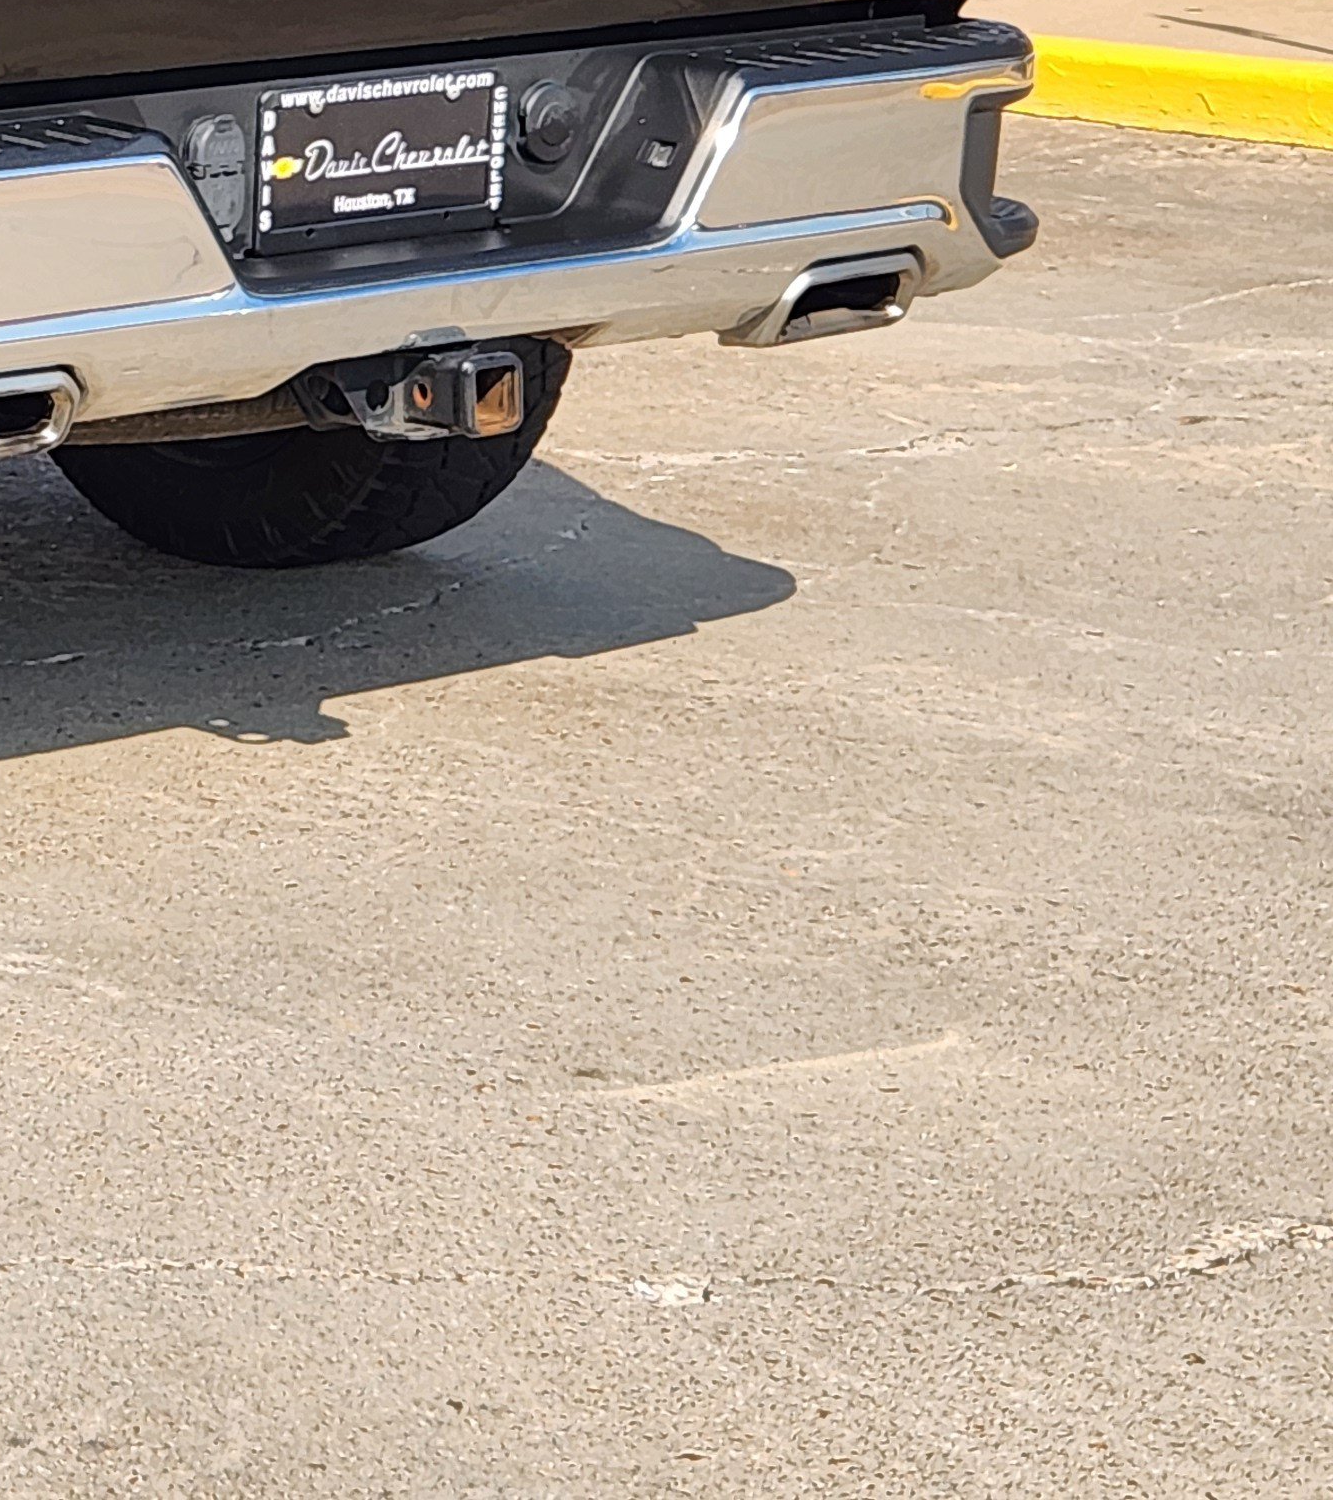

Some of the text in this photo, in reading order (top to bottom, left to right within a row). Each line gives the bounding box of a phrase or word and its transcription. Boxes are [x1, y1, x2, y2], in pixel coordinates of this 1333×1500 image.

[280, 71, 495, 109] www.davischevrolet.com
[258, 110, 278, 233] DAVIS
[304, 130, 491, 182] Davis Chevrolet
[489, 85, 509, 211] CHEVROLET
[393, 186, 417, 206] TX
